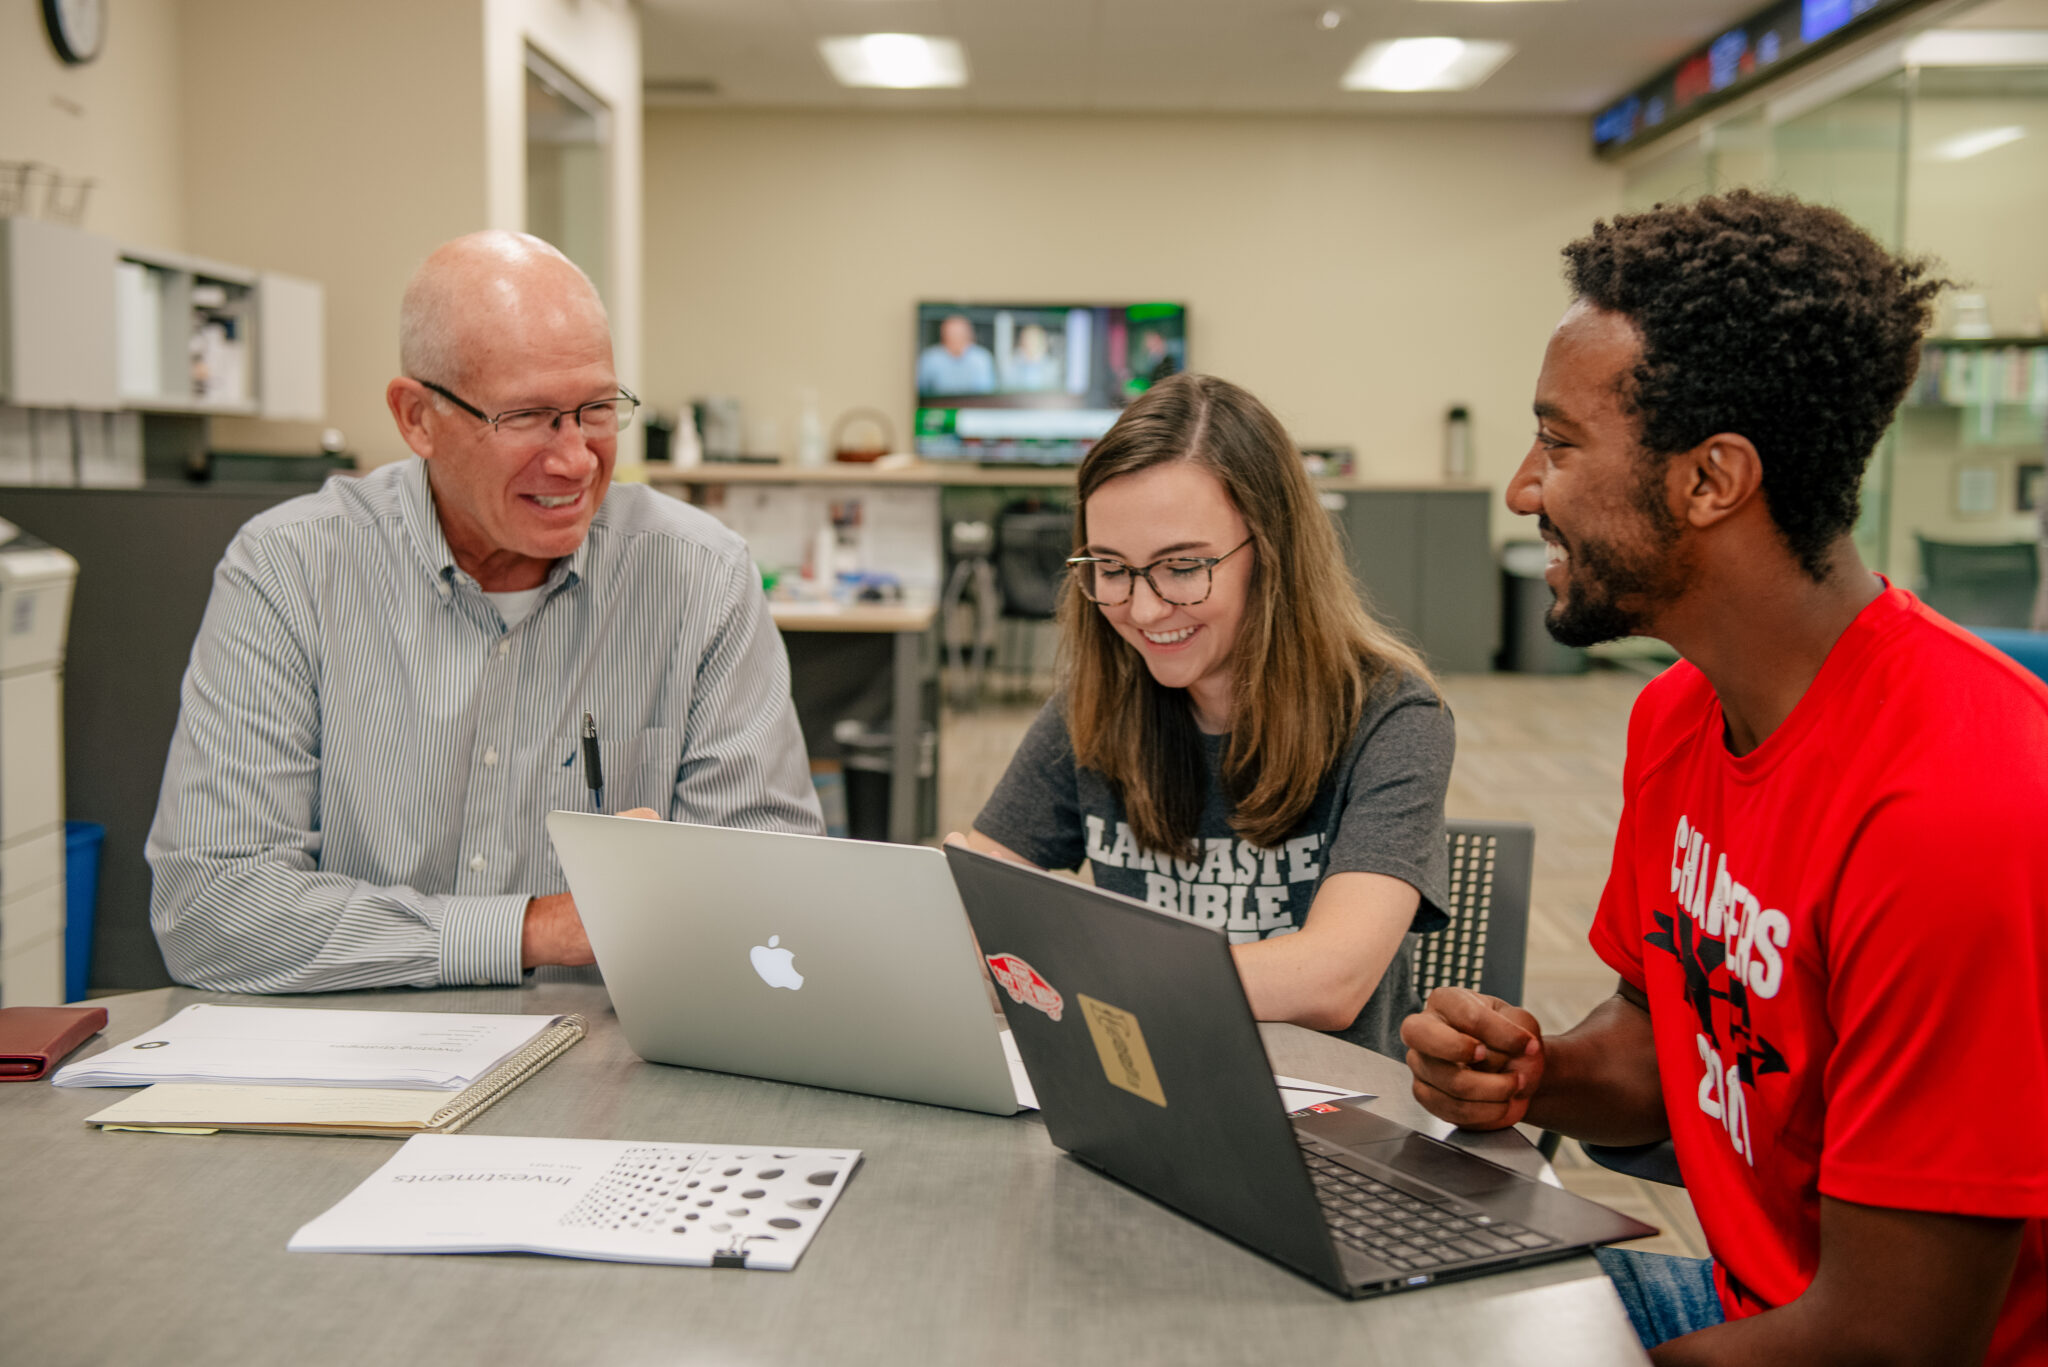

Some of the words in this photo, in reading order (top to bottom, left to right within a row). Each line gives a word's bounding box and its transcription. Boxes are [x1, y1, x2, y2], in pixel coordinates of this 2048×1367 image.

[1086, 814, 1326, 887] LANCASTE
[1145, 872, 1293, 931] BIBLE
[392, 1173, 573, 1187] Investments
